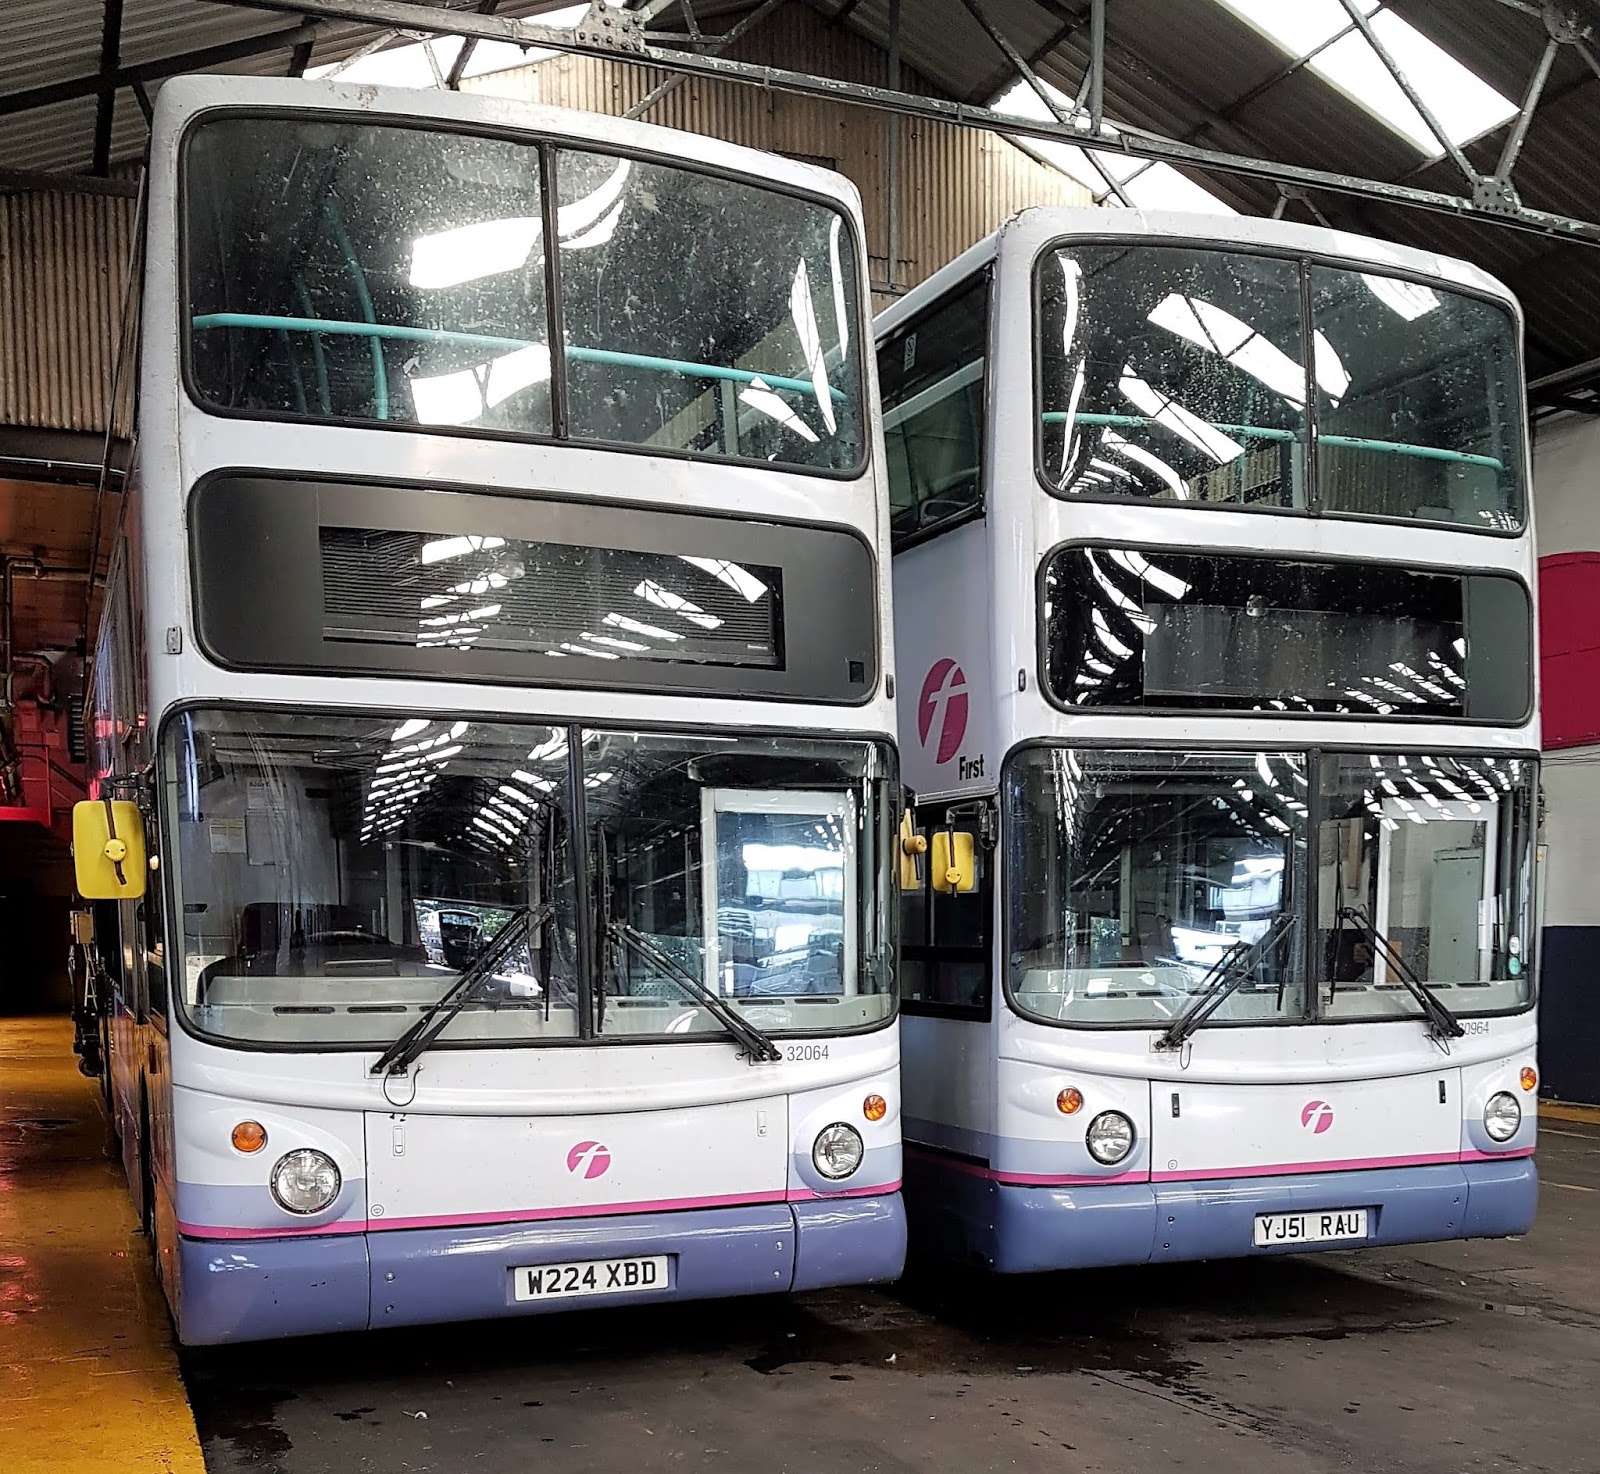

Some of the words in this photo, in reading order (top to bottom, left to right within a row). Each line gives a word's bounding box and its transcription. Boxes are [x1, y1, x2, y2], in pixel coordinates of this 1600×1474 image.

[958, 753, 985, 781] First
[787, 1045, 830, 1062] 32064
[1261, 1216, 1305, 1240] YJ51
[1320, 1213, 1360, 1236] RAU
[527, 1265, 598, 1295] W224
[606, 1260, 657, 1288] XBD
